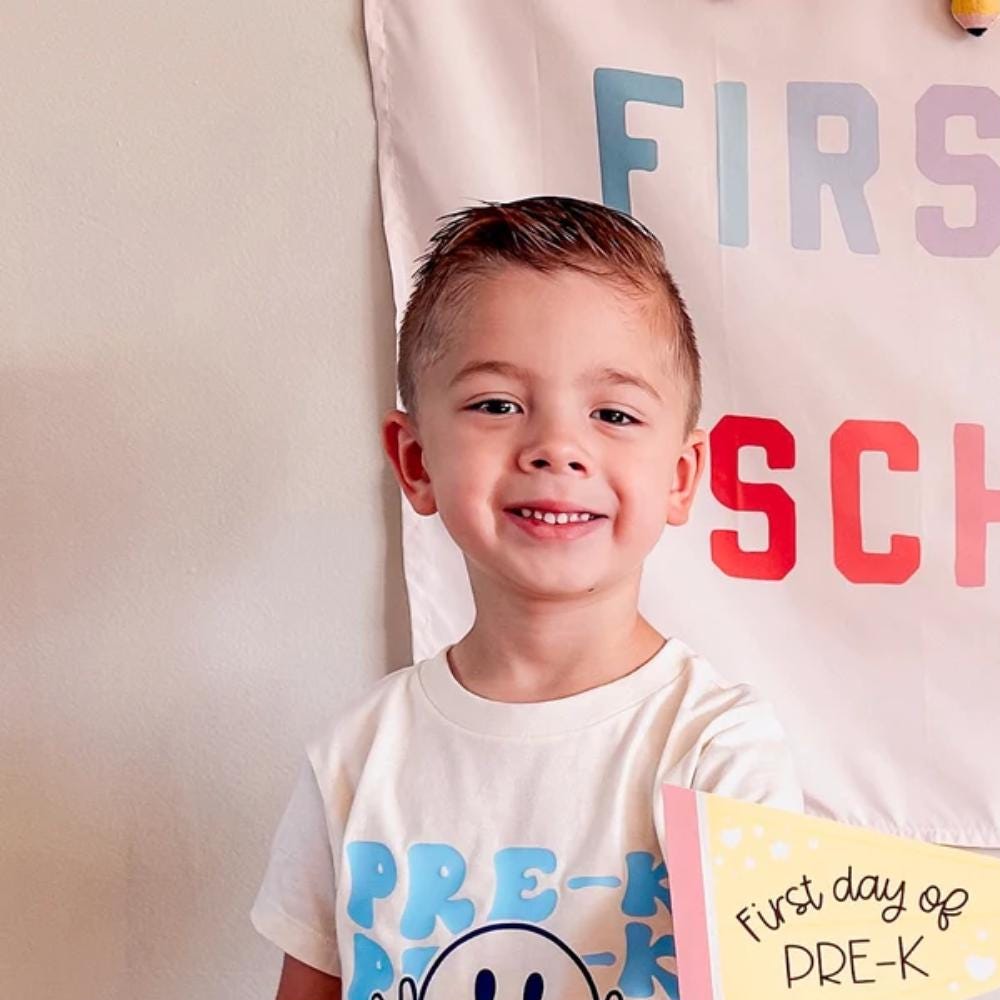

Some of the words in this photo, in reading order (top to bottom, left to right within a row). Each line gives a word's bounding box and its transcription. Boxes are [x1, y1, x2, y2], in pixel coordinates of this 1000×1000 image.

[347, 841, 672, 940] PRE-K
[735, 874, 824, 942] First
[833, 866, 907, 923] day
[918, 884, 970, 931] of
[784, 935, 929, 989] PRE-K
